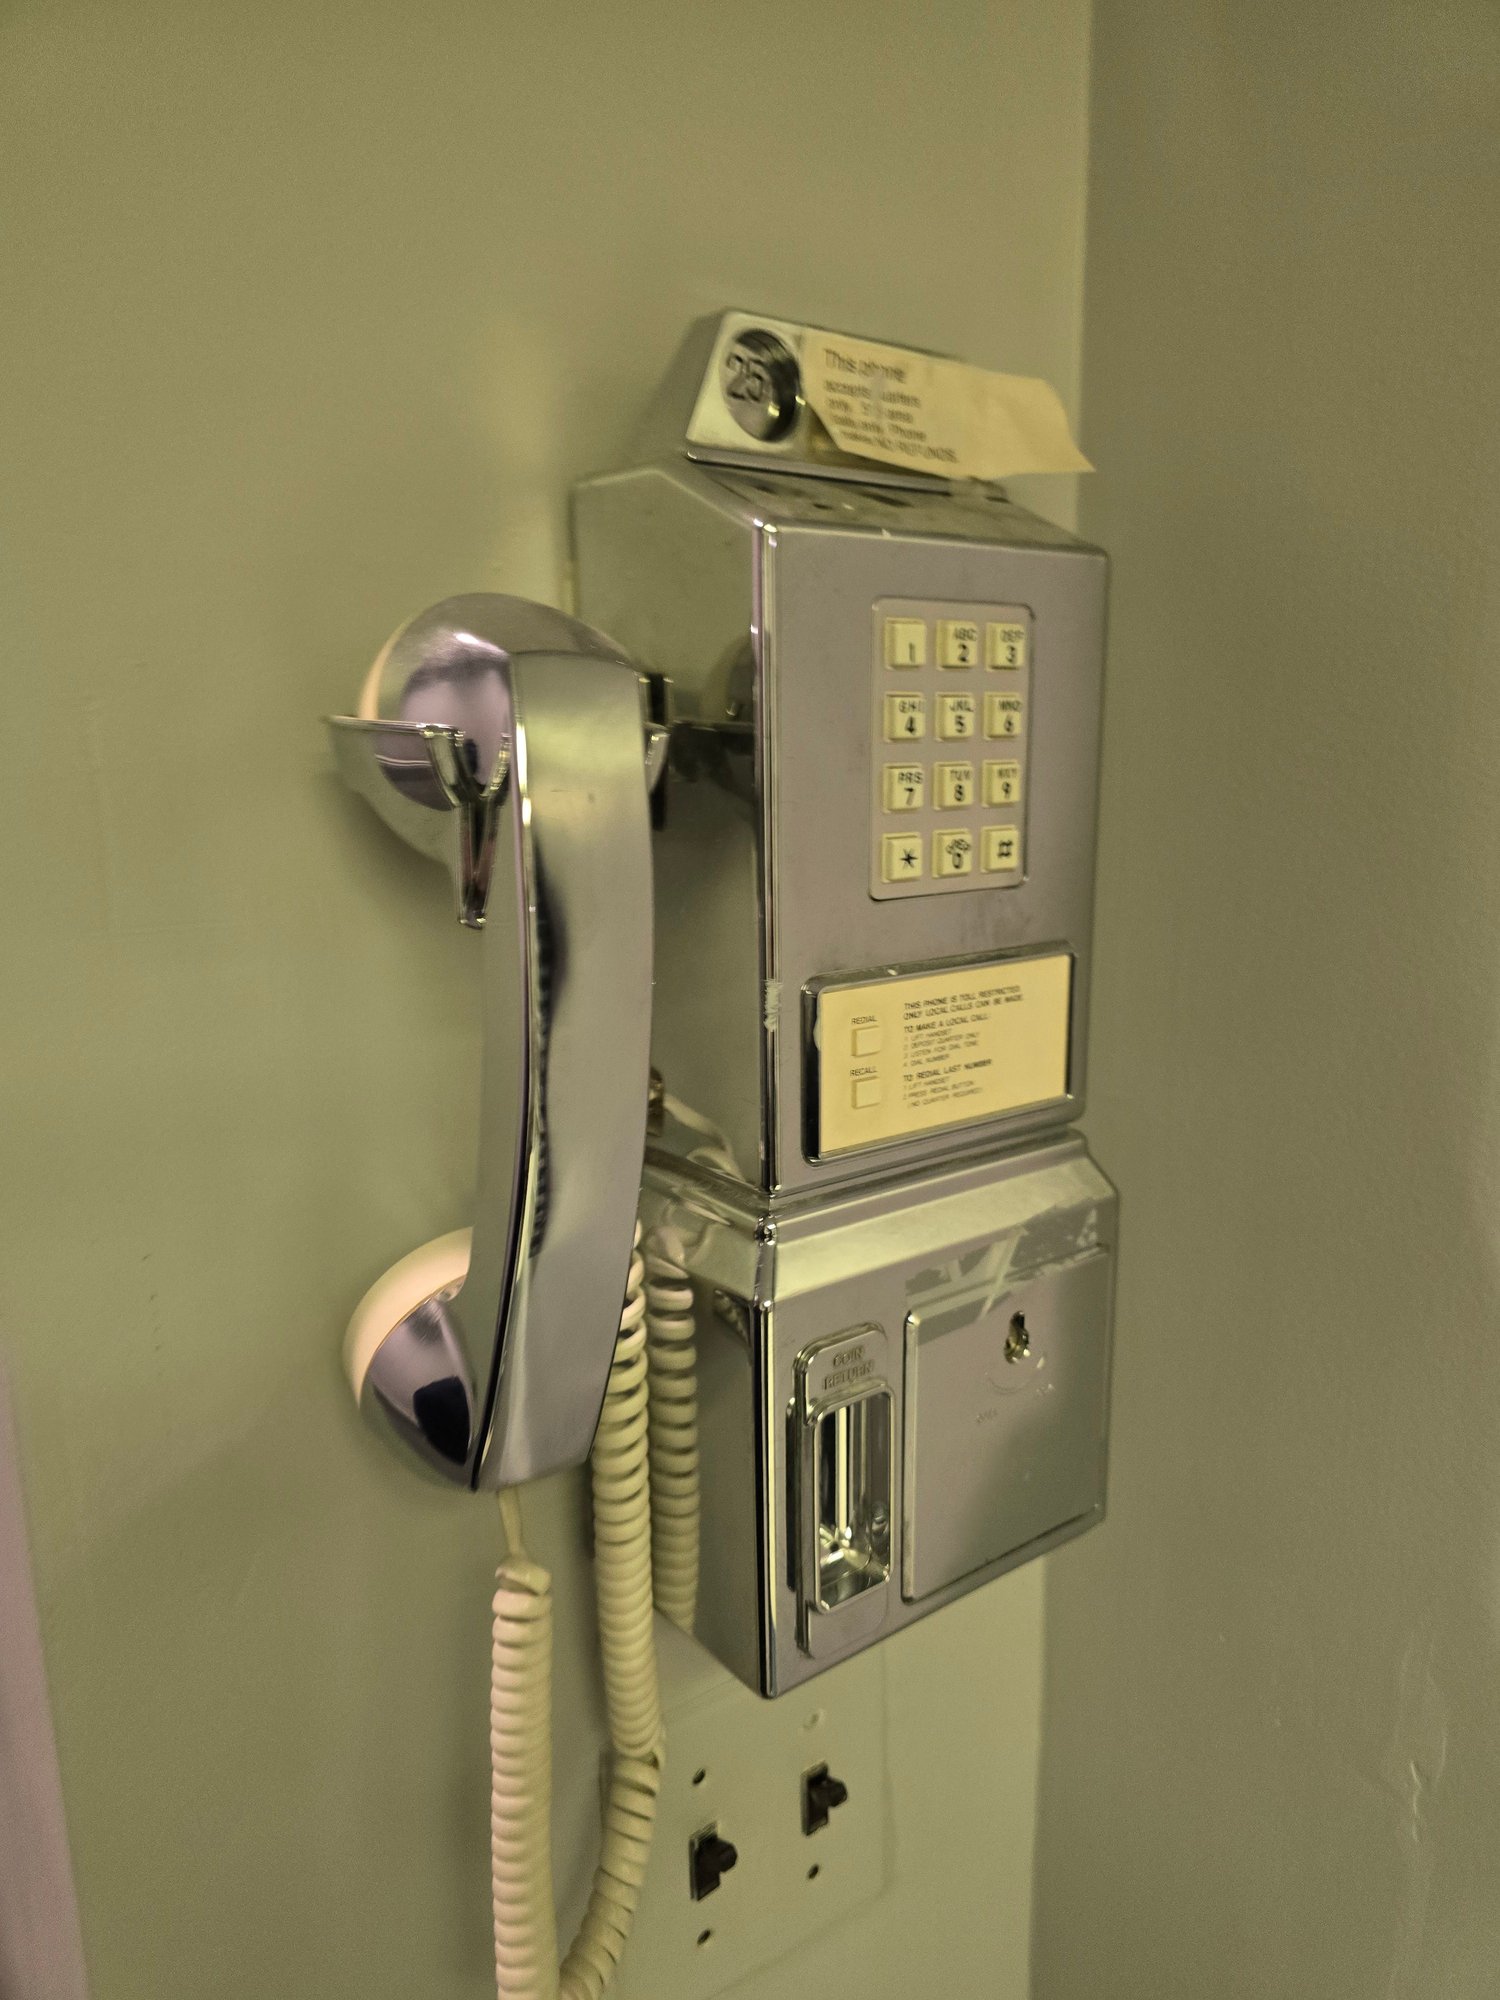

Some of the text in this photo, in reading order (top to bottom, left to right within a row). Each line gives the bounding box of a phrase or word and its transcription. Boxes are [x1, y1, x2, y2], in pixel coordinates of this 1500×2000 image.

[908, 642, 916, 662] 1
[958, 644, 970, 662] 2
[1006, 645, 1018, 664] 3
[904, 716, 917, 735] 4
[954, 715, 966, 734] 5
[1004, 714, 1014, 733] 6
[903, 787, 915, 806] 7
[954, 784, 965, 801] 8
[1002, 781, 1012, 799] 9
[903, 1011, 922, 1020] ONLY
[925, 1007, 948, 1016] LOCAL
[949, 1002, 973, 1012] CALLS
[975, 1000, 990, 1008] CAN
[904, 1001, 920, 1010] THIS
[923, 997, 947, 1006] PHONE
[951, 995, 957, 1003] IS
[851, 1015, 878, 1024] REDIAL
[904, 1025, 913, 1033] TO
[916, 1021, 936, 1031] MAKE
[946, 1016, 968, 1026] LOCAL
[849, 1066, 878, 1076] RECALL
[904, 1074, 913, 1082] TO
[917, 1069, 941, 1078] REDIAL
[944, 1064, 961, 1074] LAST
[832, 1345, 865, 1367] COIN
[822, 1360, 874, 1390] RETURN
